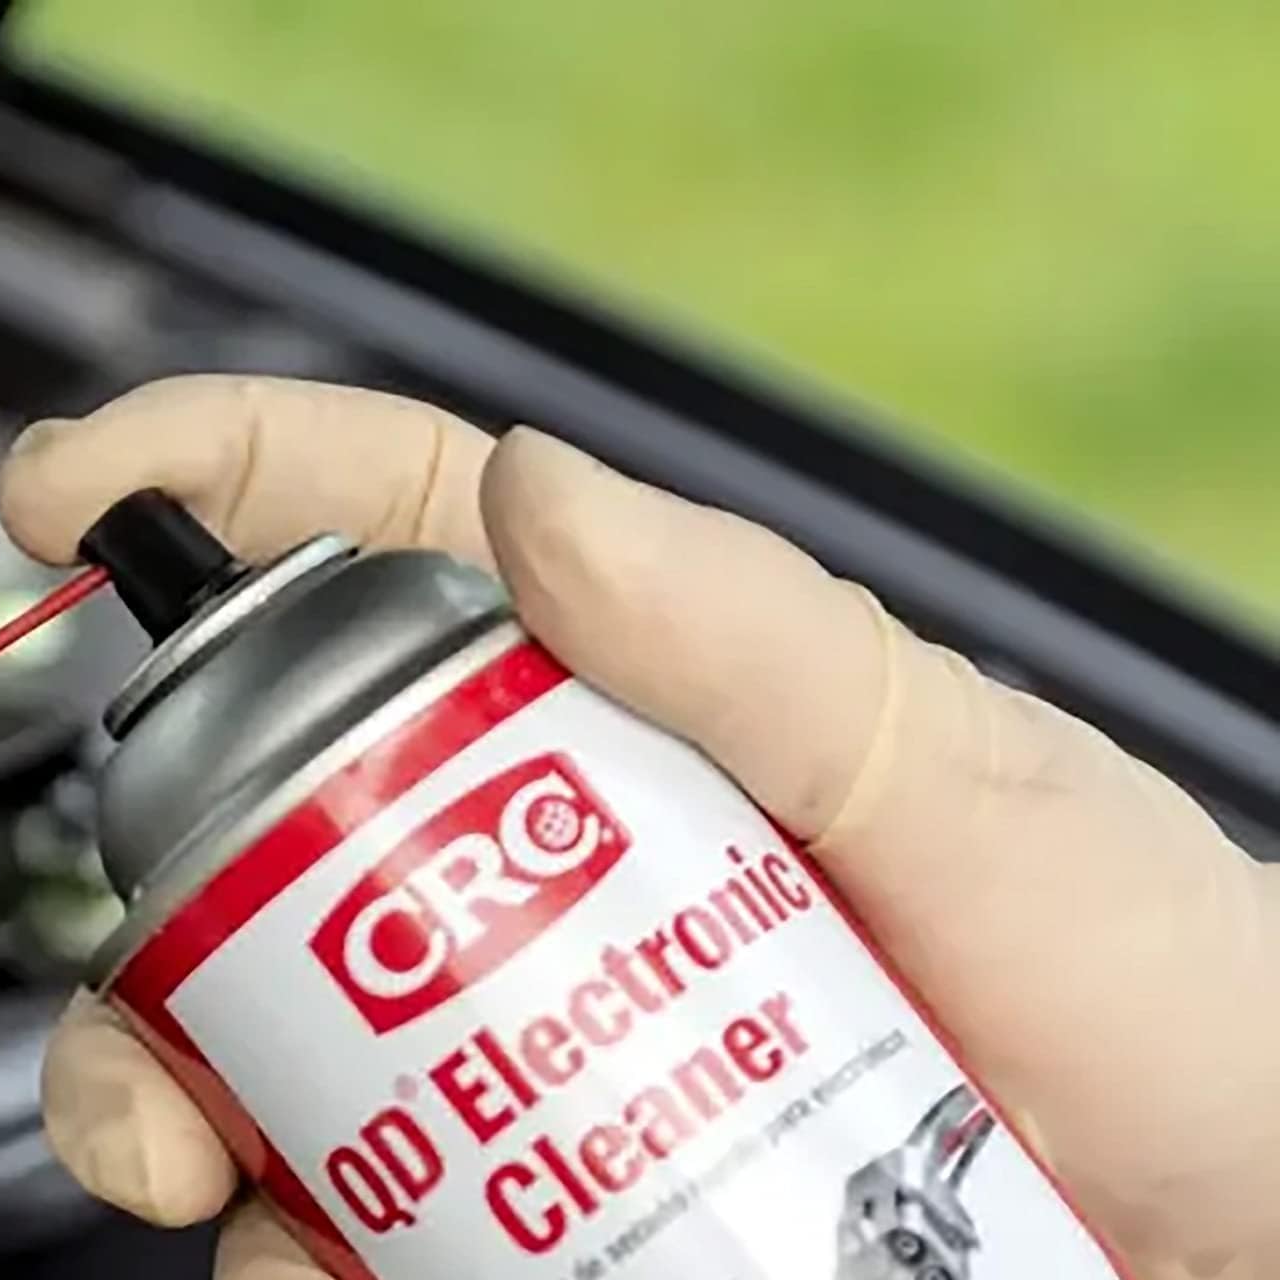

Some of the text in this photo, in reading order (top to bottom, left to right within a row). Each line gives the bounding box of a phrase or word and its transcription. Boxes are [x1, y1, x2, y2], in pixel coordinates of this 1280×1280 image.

[342, 769, 601, 999] CRC
[427, 844, 813, 1147] Electronic
[484, 991, 810, 1255] Cleaner
